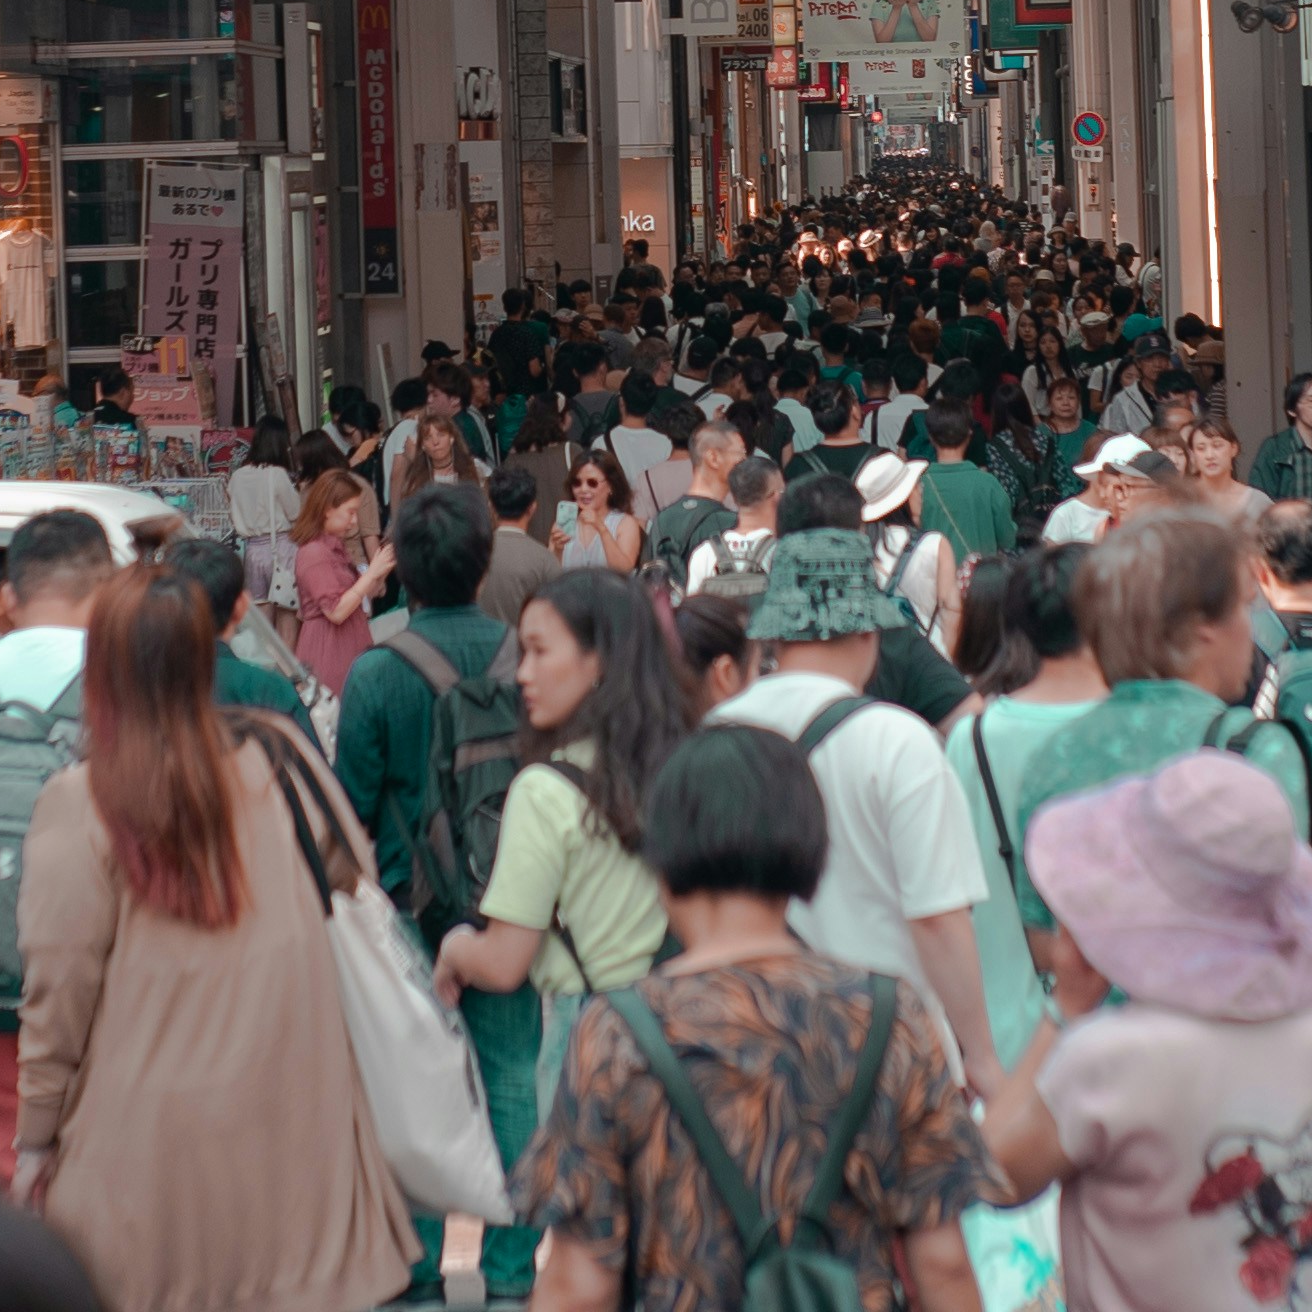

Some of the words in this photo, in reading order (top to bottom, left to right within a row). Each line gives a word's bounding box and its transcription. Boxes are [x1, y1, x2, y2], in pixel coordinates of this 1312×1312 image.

[752, 8, 769, 22] 06
[738, 24, 769, 38] 2400
[364, 48, 390, 198] McDonald's
[171, 203, 210, 217] あるで
[367, 262, 396, 282] 24
[164, 237, 192, 333] ガールズ
[194, 238, 224, 360] プリ専門店
[153, 334, 187, 376] 11
[132, 387, 190, 402] ショップ
